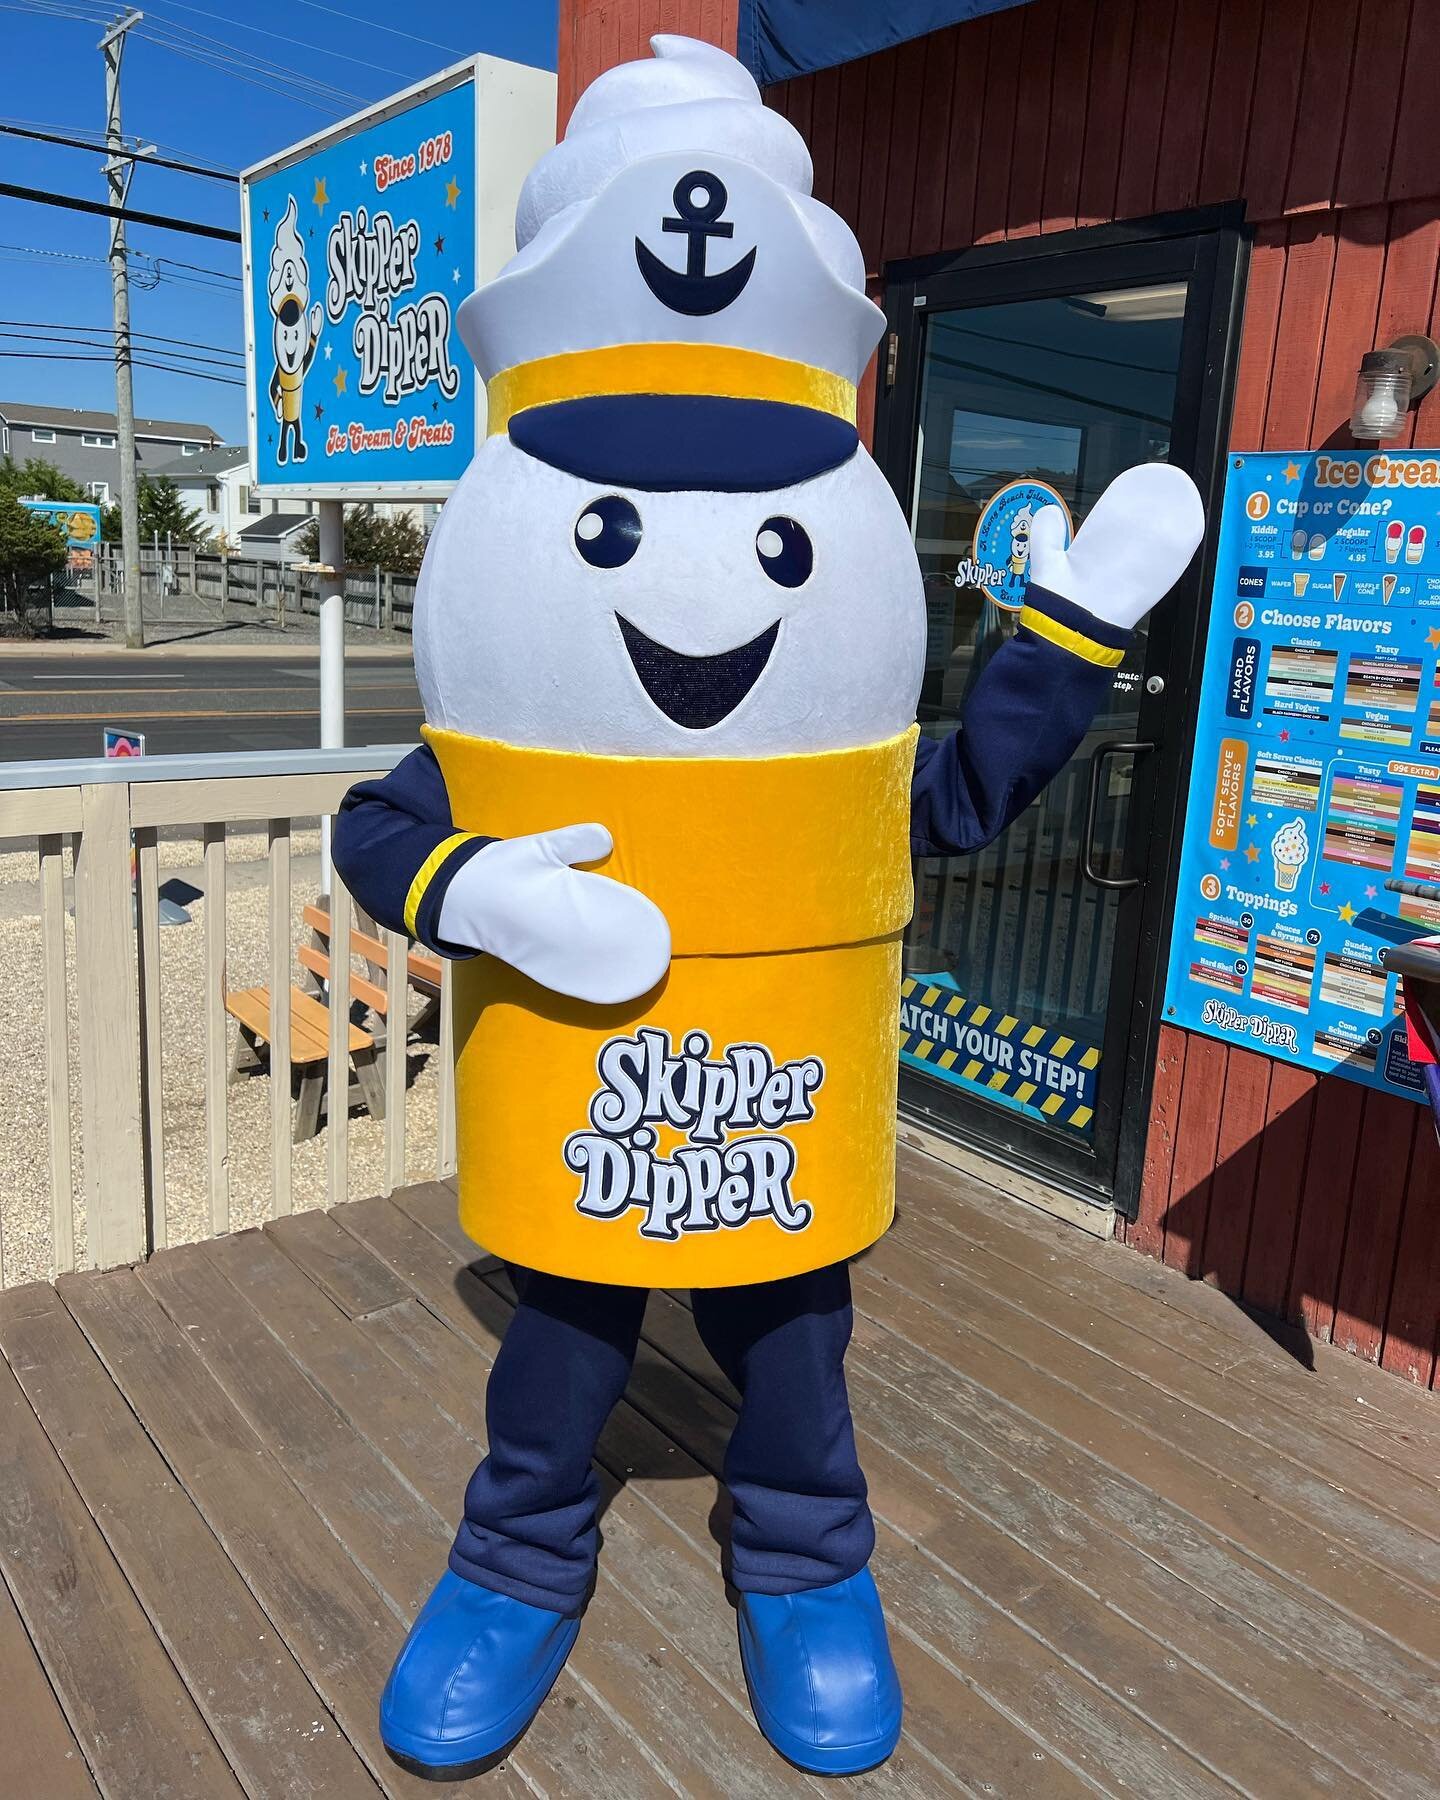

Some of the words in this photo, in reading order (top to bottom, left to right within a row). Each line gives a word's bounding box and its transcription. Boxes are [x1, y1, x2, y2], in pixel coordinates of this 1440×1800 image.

[375, 154, 414, 191] Since
[418, 132, 452, 170] 1978
[326, 424, 346, 456] Ice
[348, 420, 392, 453] Cream
[394, 420, 407, 447] &
[409, 419, 454, 450] Treats
[1315, 456, 1362, 487] Ice
[1364, 455, 1440, 488] Crea
[999, 492, 1024, 511] Beach
[1253, 497, 1262, 514] 1
[1277, 499, 1308, 517] Cup
[1313, 501, 1332, 514] or
[1337, 499, 1392, 515] Cone?
[1251, 526, 1278, 535] Kiddie
[1336, 528, 1370, 538] Regular
[1258, 550, 1274, 558] 3.95
[1348, 554, 1366, 562] 4.95
[1240, 578, 1264, 586] CONES
[1238, 606, 1249, 624] 2
[1261, 610, 1320, 629] Choose
[1325, 610, 1393, 634] Flavors
[1291, 638, 1321, 647] Classics
[1375, 645, 1399, 655] Tasty
[1232, 658, 1244, 699] HARD
[1240, 646, 1256, 712] FLAVORS
[1113, 681, 1134, 692] step.
[1274, 700, 1294, 709] Hard
[1295, 702, 1320, 713] Yogurt
[1365, 712, 1389, 721] Vegan
[1257, 750, 1272, 758] Soft
[1273, 753, 1293, 761] Serve
[1294, 756, 1323, 766] Classics
[1358, 766, 1381, 776] Tasty
[1393, 764, 1408, 773] 99¢
[1410, 766, 1435, 777] EXTRA
[1216, 800, 1227, 837] SOFT
[1222, 750, 1234, 795] SERVE
[1227, 763, 1241, 827] FLAVORS
[1206, 879, 1216, 895] 3
[1226, 885, 1298, 917] Toppings
[1209, 912, 1239, 926] Sprinkles
[1275, 922, 1301, 934] Sauces
[1308, 933, 1318, 941] .75
[1277, 931, 1303, 944] Syrups
[1344, 939, 1373, 953] Sundae
[1342, 948, 1373, 961] Classics
[1200, 957, 1217, 968] Hard
[1217, 961, 1234, 973] Shell
[1338, 1021, 1357, 1032] Cone
[1328, 1026, 1366, 1043] Schmears
[900, 1002, 948, 1042] ATCH
[953, 1021, 1014, 1070] YOUR
[1018, 1049, 1085, 1099] STEP!
